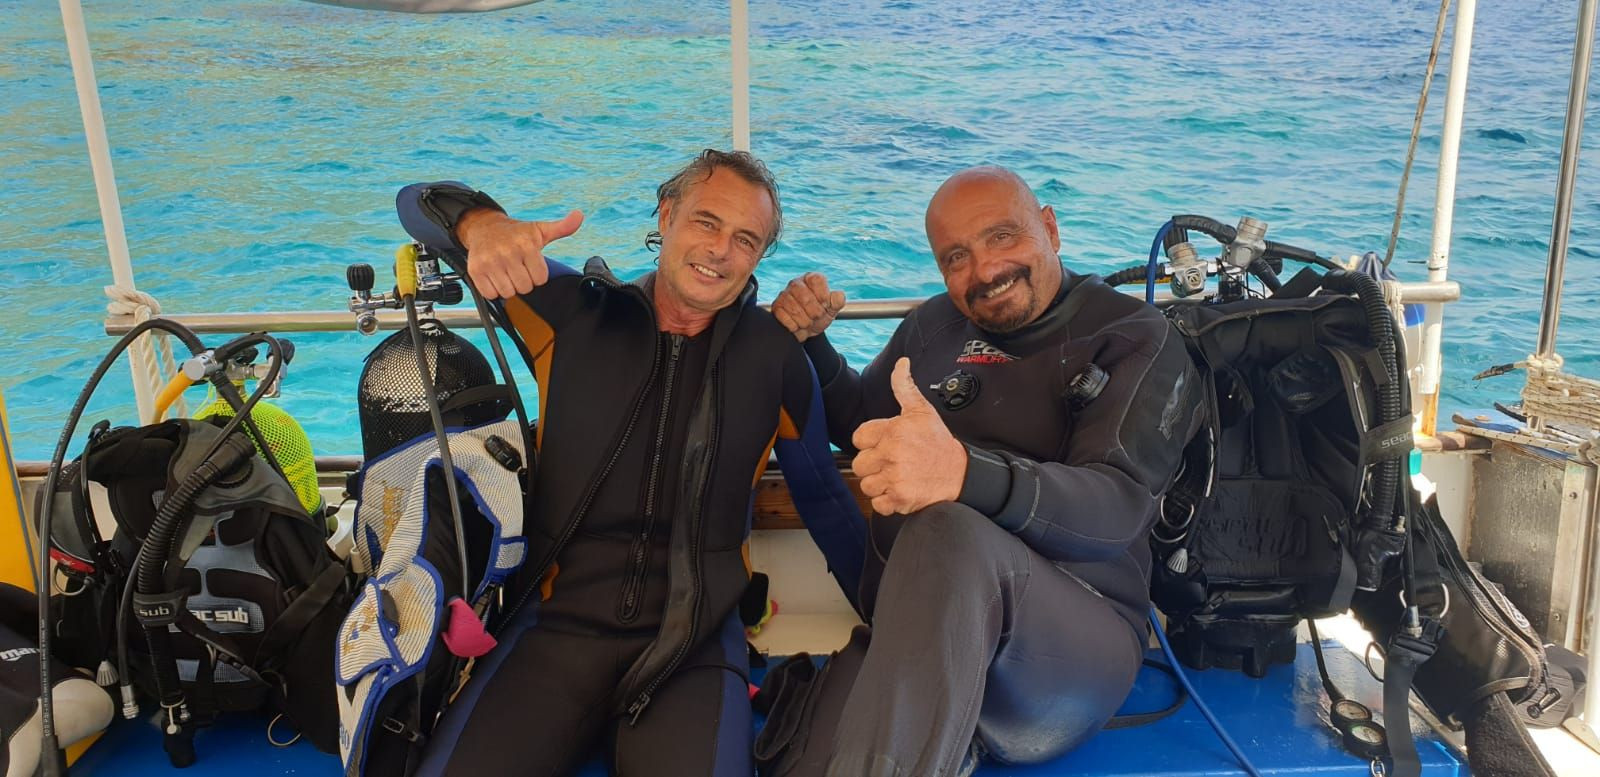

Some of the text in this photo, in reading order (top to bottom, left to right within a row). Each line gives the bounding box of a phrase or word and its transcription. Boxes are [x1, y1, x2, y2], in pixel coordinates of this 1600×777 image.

[139, 606, 170, 617] sub
[215, 607, 249, 623] sub
[0, 647, 40, 661] mar
